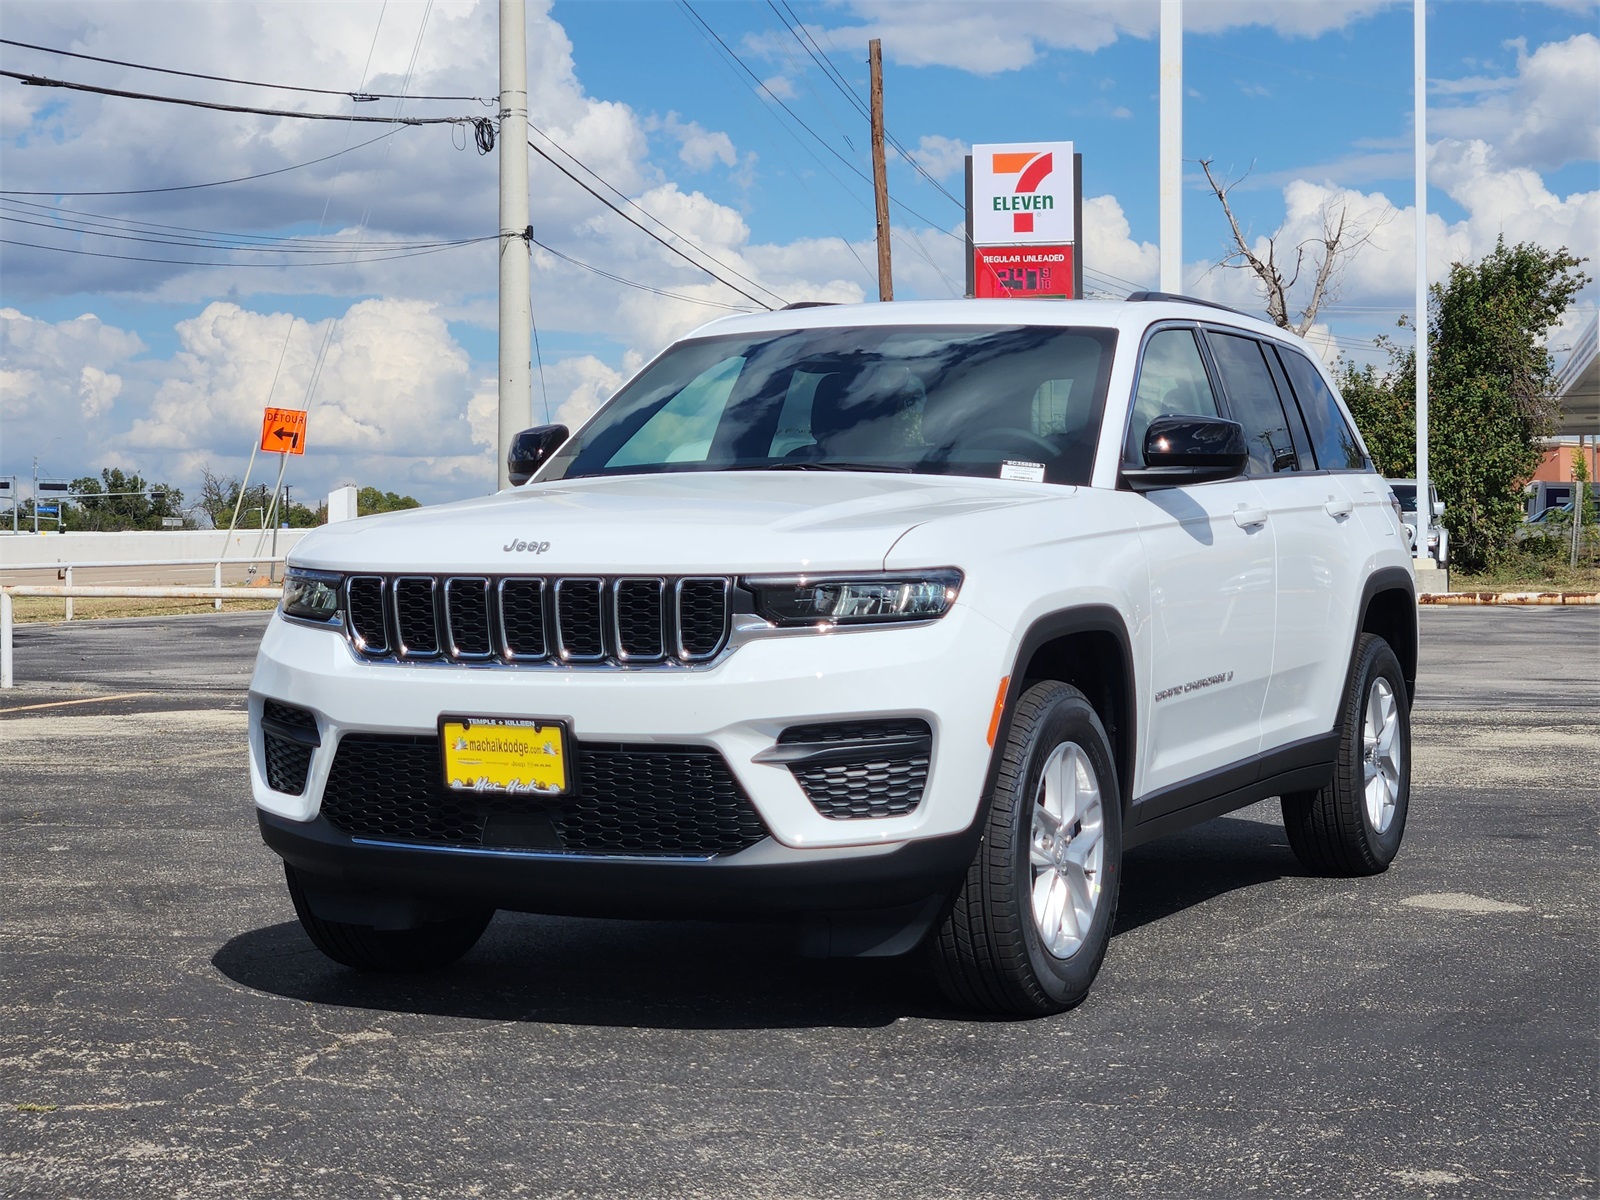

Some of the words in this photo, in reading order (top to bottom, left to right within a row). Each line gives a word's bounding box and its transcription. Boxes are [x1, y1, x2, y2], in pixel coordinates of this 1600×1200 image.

[983, 255, 1021, 263] REGULAR
[1022, 254, 1065, 263] UNLEADED
[267, 413, 304, 424] DETOUR
[503, 538, 551, 555] Jeep
[467, 718, 496, 726] TEMPLE
[469, 737, 542, 757] machaikdodge.com
[474, 776, 501, 793] Mac
[505, 778, 538, 794] Haik
